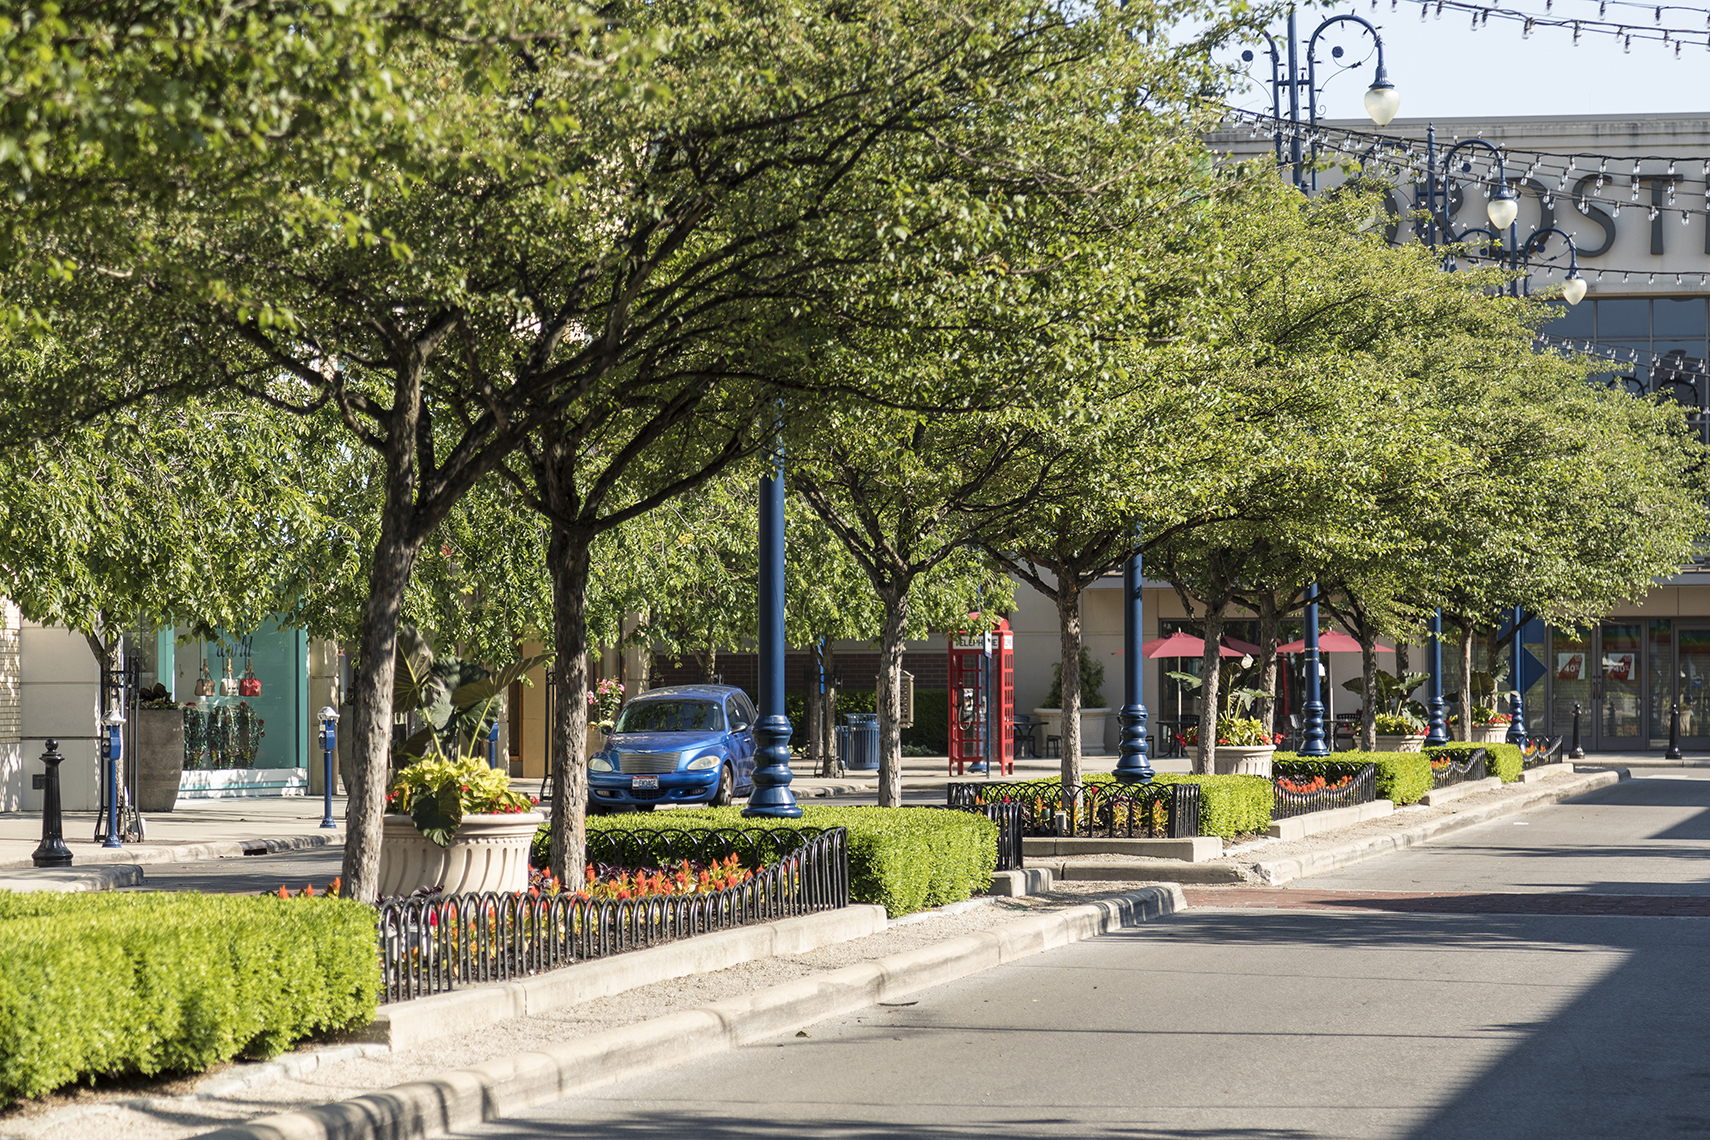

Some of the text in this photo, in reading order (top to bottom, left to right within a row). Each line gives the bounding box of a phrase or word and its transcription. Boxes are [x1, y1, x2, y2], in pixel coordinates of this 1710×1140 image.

[955, 638, 998, 647] ELEPHE
[1564, 664, 1579, 672] 40%
[1613, 664, 1629, 672] 40%
